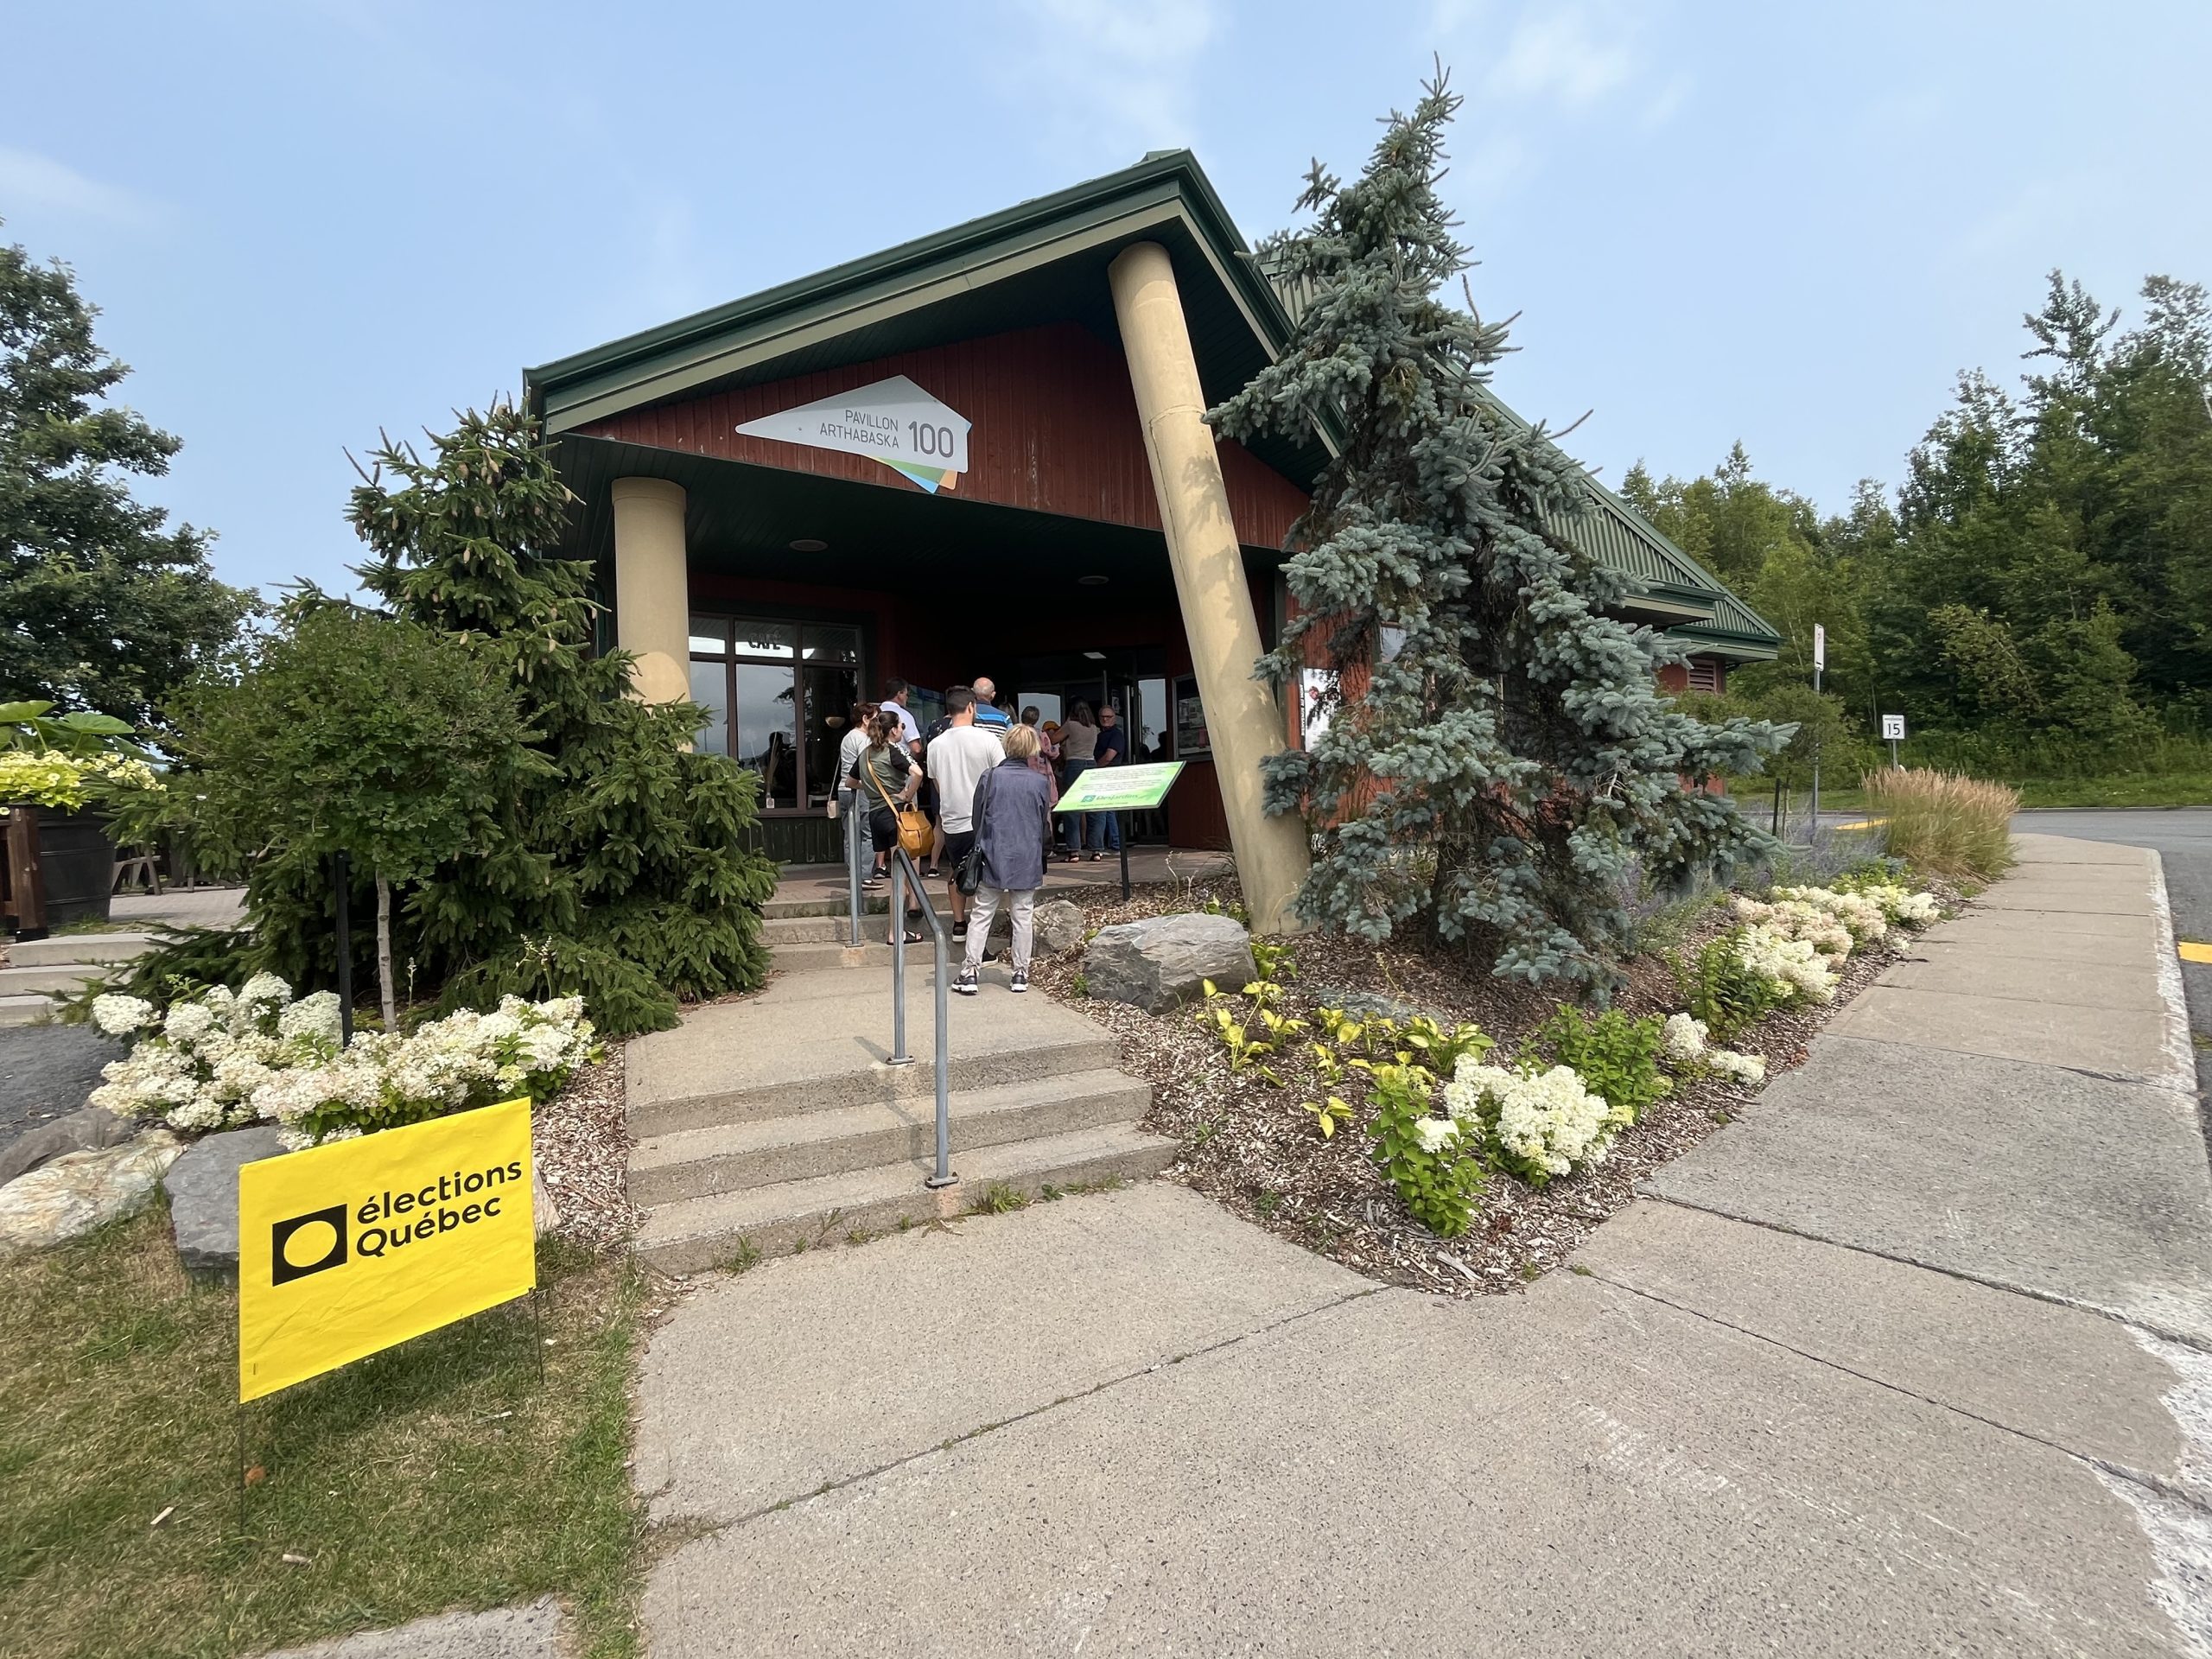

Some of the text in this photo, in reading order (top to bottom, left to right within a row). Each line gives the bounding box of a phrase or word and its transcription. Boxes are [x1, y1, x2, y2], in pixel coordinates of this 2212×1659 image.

[819, 422, 899, 448] ARTHABASKA
[845, 409, 899, 432] PAVILLON
[908, 420, 955, 458] 100
[1887, 723, 1901, 735] 15
[356, 1161, 522, 1224] élections
[356, 1197, 501, 1257] Québec
